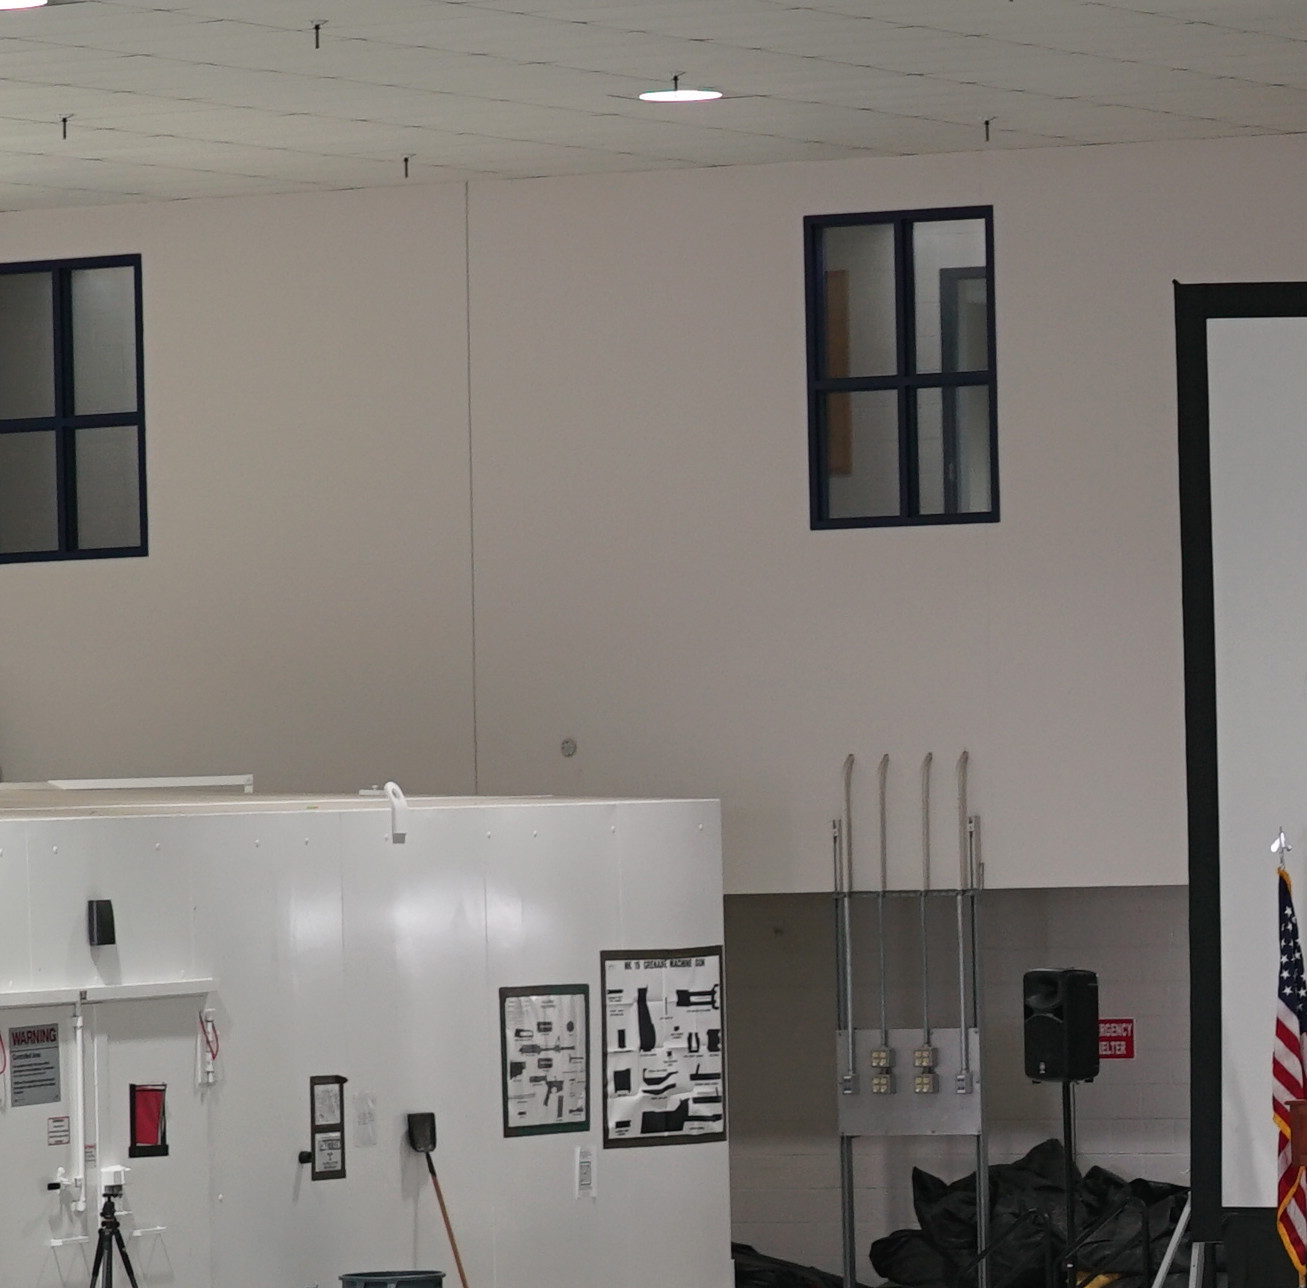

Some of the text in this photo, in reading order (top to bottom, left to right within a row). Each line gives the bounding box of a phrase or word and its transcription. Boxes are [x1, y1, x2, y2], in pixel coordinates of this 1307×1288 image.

[12, 1027, 57, 1046] WARNING
[1099, 1023, 1132, 1037] RGENCY
[1099, 1041, 1126, 1055] ELTER
